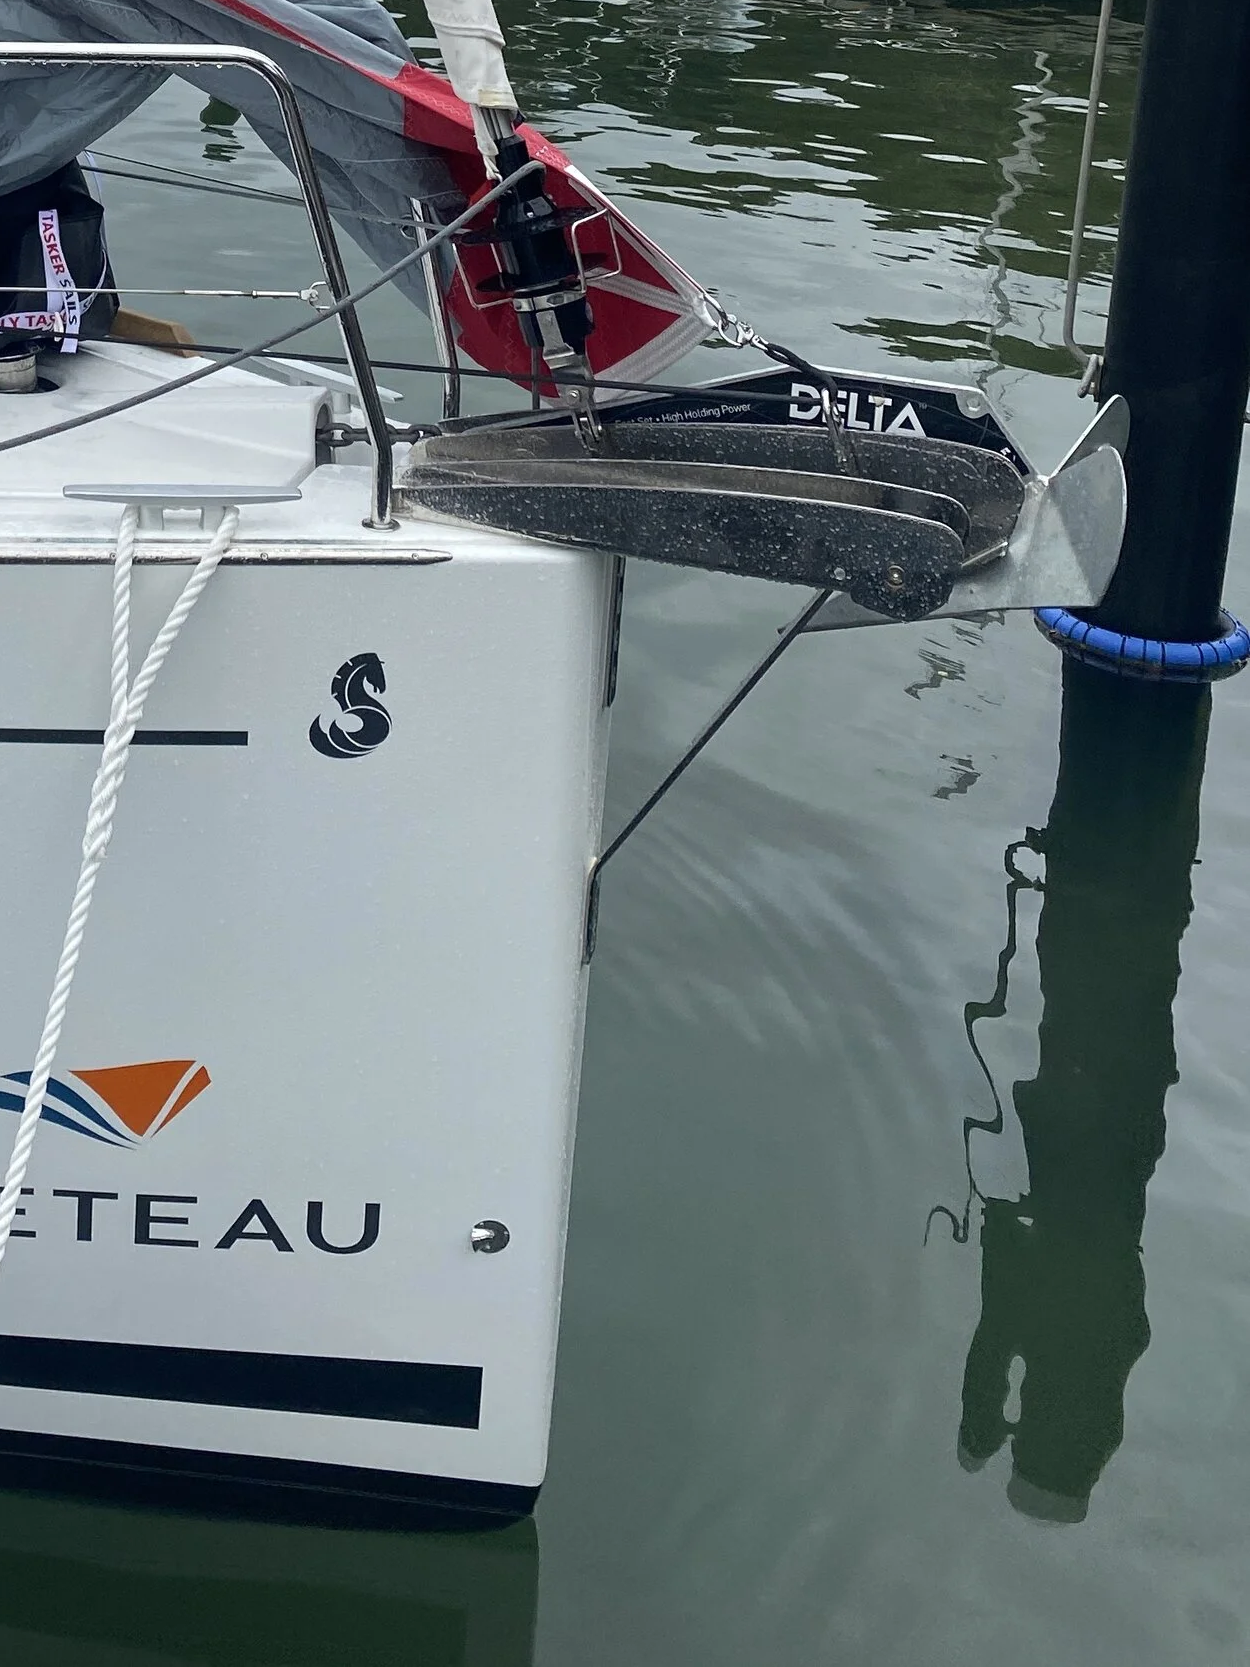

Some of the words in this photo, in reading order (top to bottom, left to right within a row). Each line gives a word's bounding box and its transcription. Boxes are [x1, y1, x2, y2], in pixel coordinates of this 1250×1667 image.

[41, 214, 66, 276] TASKER
[59, 278, 78, 326] SAILS
[661, 411, 685, 424] High
[684, 408, 721, 421] Holding
[720, 403, 752, 415] Power
